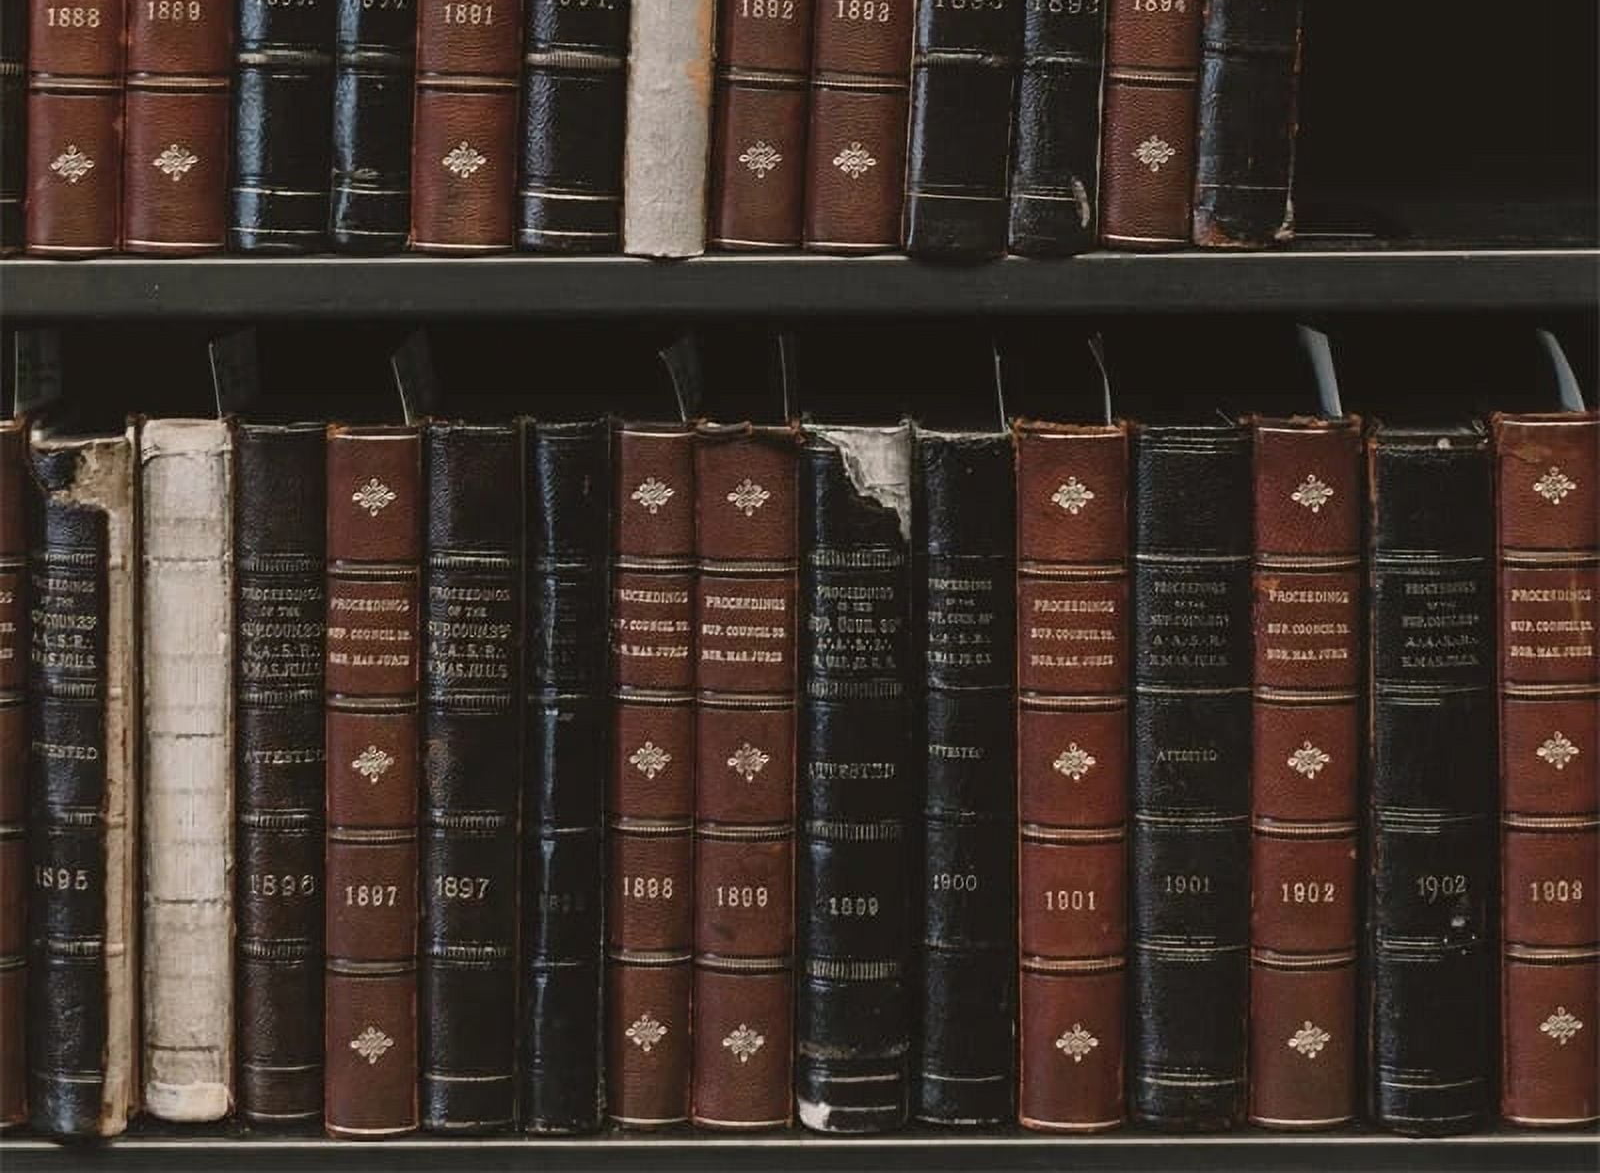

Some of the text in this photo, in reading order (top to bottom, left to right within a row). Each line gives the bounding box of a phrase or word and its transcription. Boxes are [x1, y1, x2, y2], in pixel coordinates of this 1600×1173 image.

[47, 7, 101, 28] 1888
[148, 1, 201, 22] 1889
[443, 4, 494, 26] 1891
[836, 0, 890, 23] 1893
[433, 875, 491, 900] 1897
[623, 876, 674, 899] 1898
[1164, 875, 1212, 894] 1901
[1280, 882, 1336, 904] 1902
[1416, 874, 1470, 904] 1902
[1529, 880, 1584, 903] 1903
[343, 885, 398, 908] 1897
[1044, 890, 1097, 912] 1901
